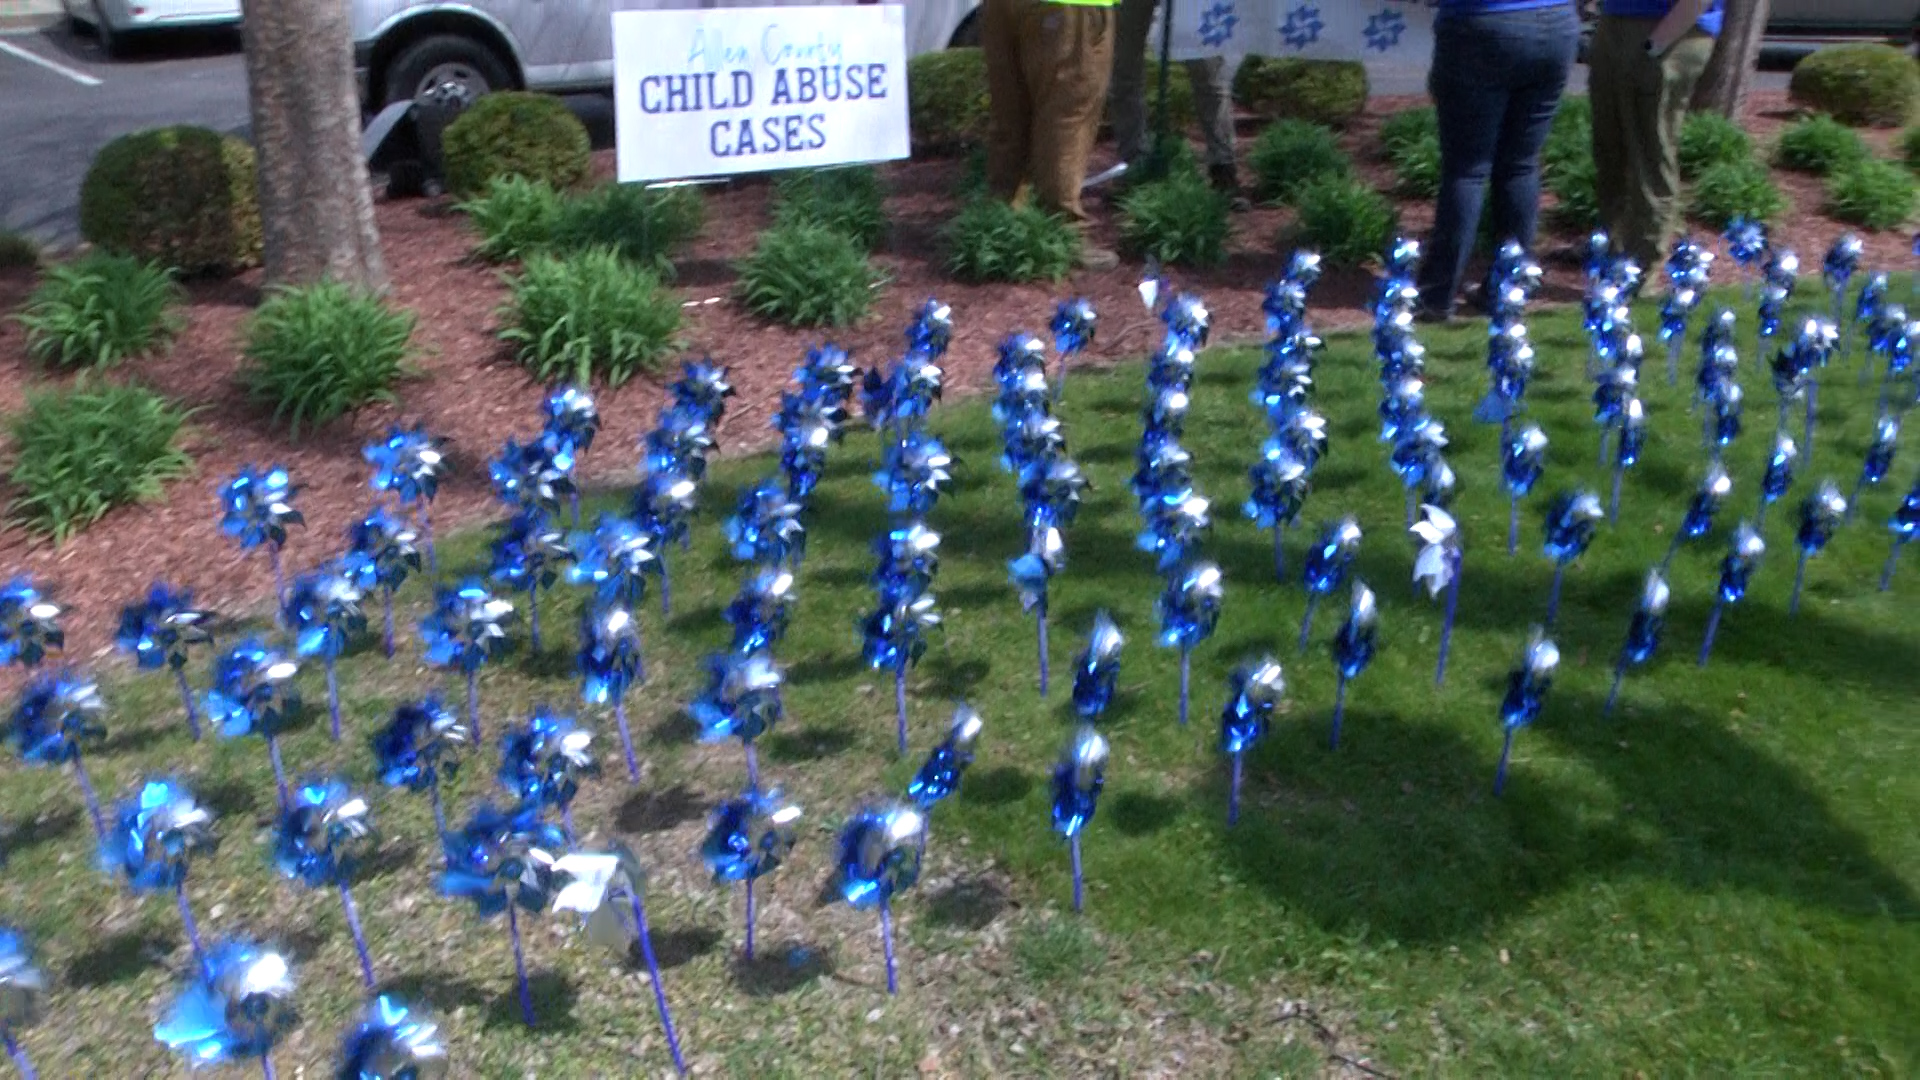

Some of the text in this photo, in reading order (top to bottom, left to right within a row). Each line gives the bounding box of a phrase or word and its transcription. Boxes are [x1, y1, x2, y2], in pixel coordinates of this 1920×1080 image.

[687, 23, 842, 66] Allen County
[640, 62, 887, 114] CHILD ABUSE
[710, 113, 826, 158] CASES
